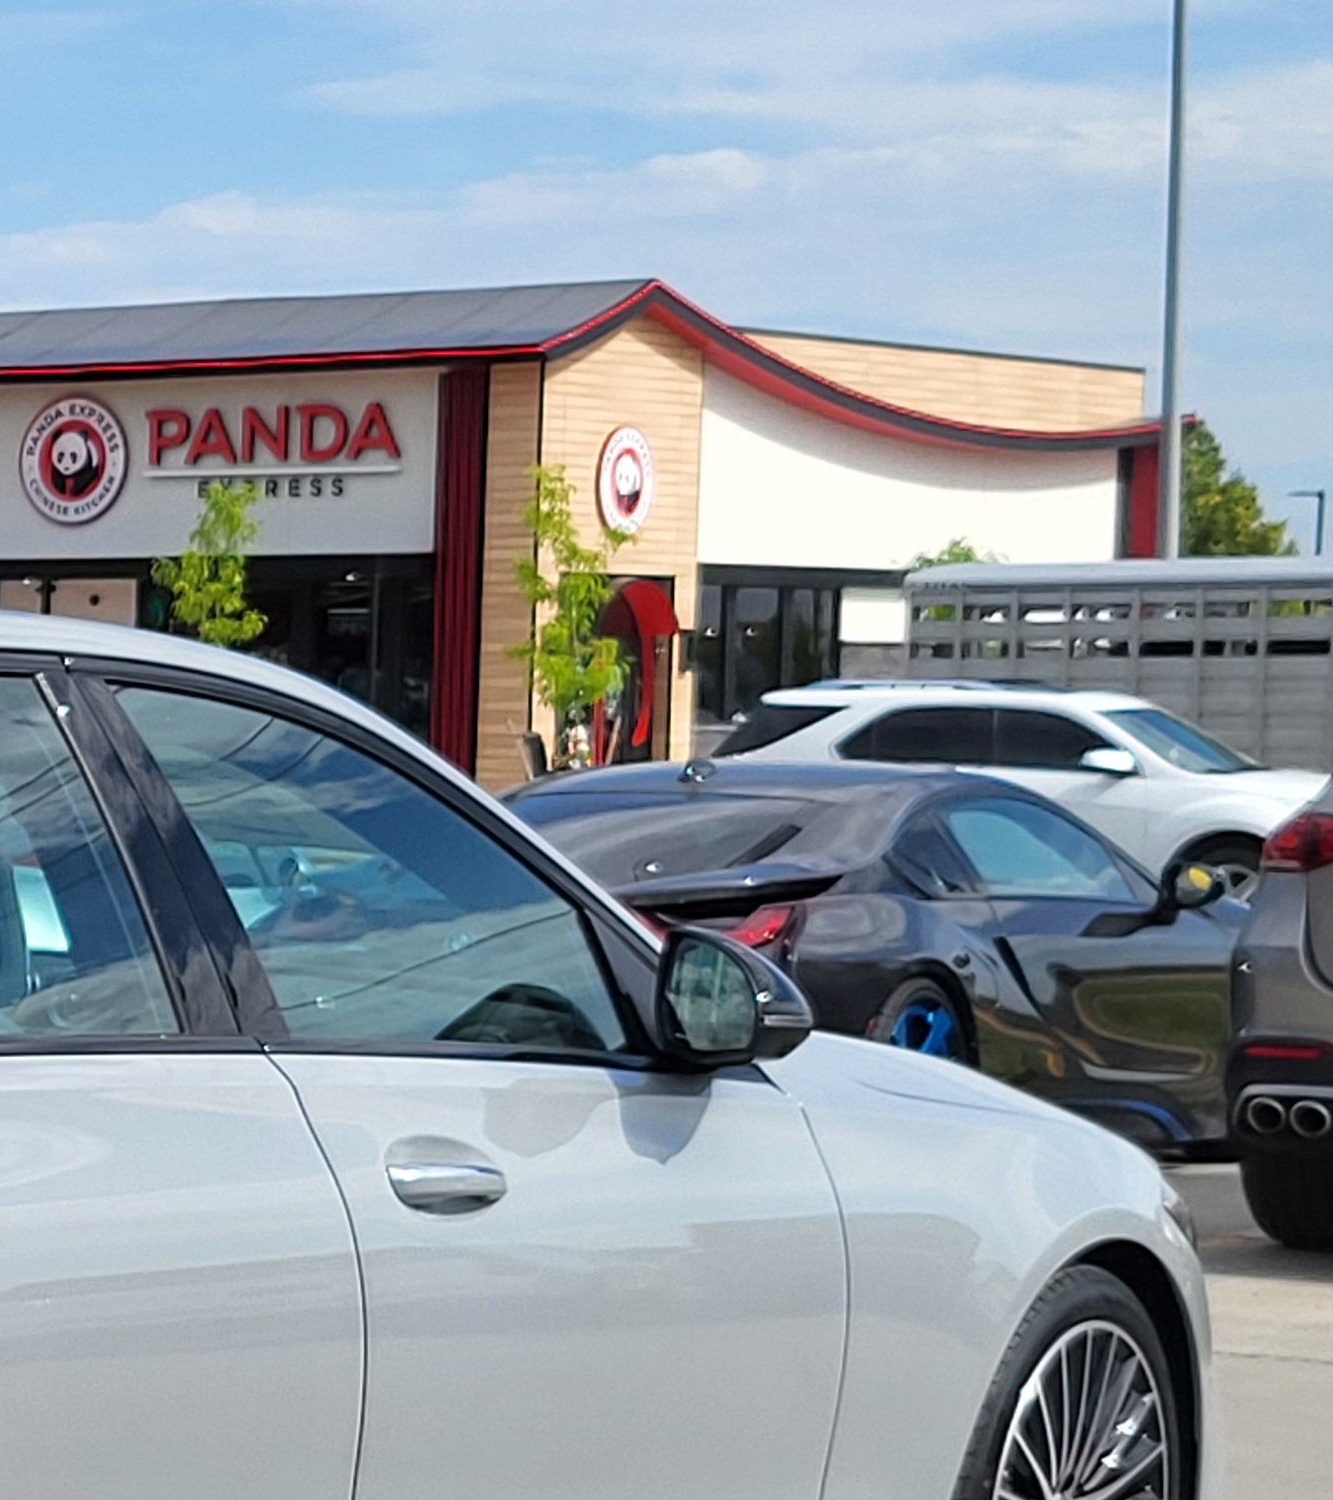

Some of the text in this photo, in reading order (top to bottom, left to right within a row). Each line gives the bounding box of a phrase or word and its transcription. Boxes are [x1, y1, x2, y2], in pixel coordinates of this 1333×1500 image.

[26, 403, 120, 457] PANDA EXPRESS
[145, 401, 401, 466] PANDA
